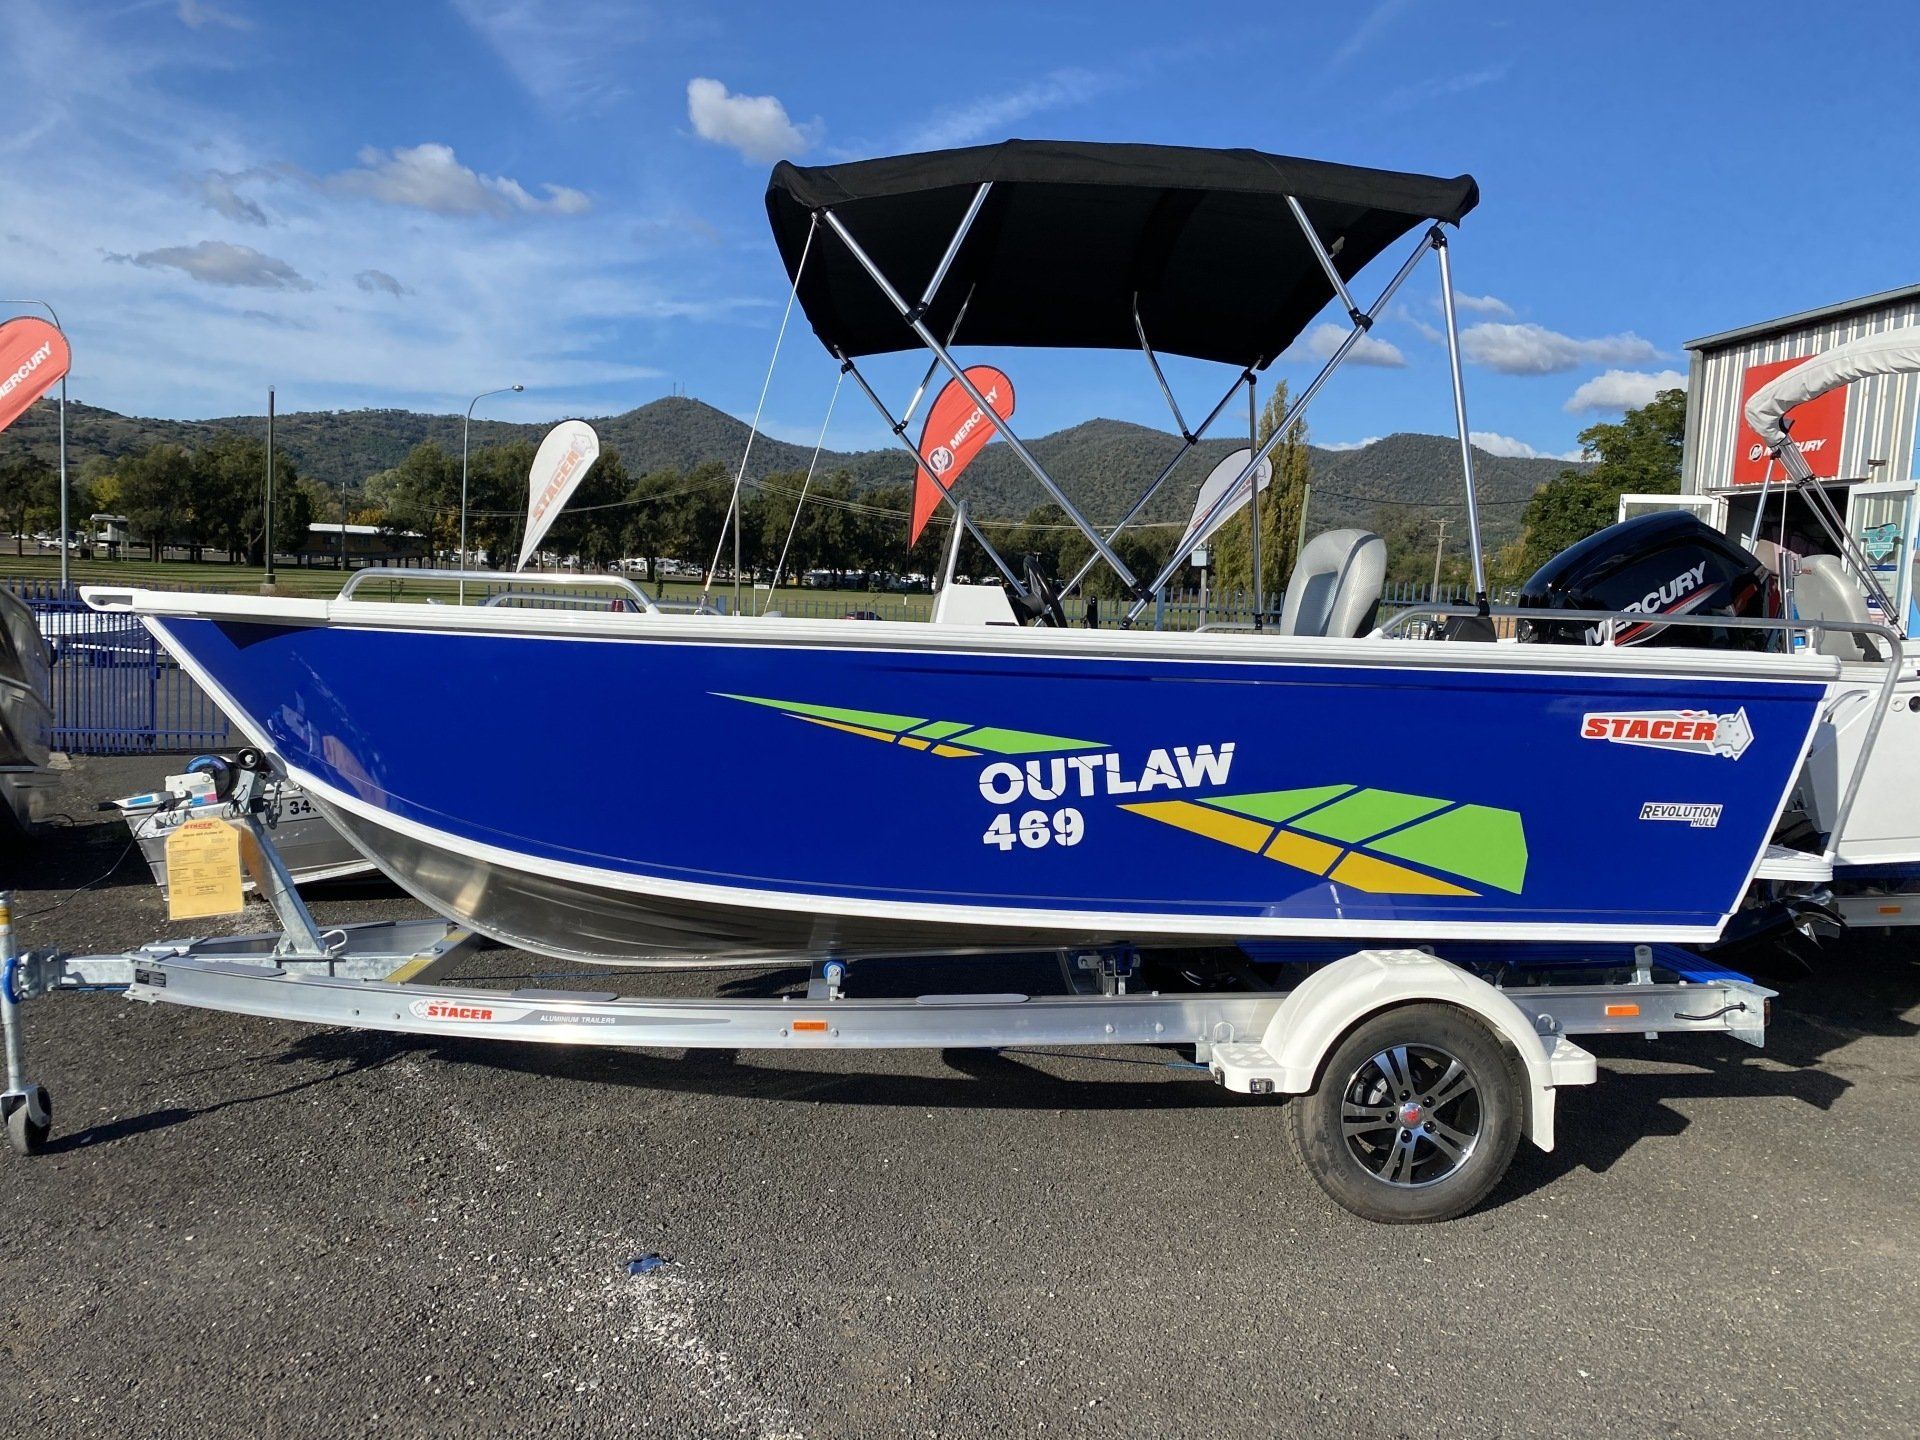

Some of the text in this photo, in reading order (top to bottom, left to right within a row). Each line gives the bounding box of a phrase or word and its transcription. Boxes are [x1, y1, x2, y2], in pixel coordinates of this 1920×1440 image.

[1584, 718, 1718, 741] STACER
[979, 742, 1236, 805] OUTLAW
[290, 799, 317, 815] 34
[1640, 804, 1722, 819] REVOLUTION
[982, 807, 1085, 851] 469
[1691, 817, 1716, 827] HULL
[427, 1005, 493, 1020] STACER
[540, 1014, 616, 1025] ALUMINIUM TRAILERS
